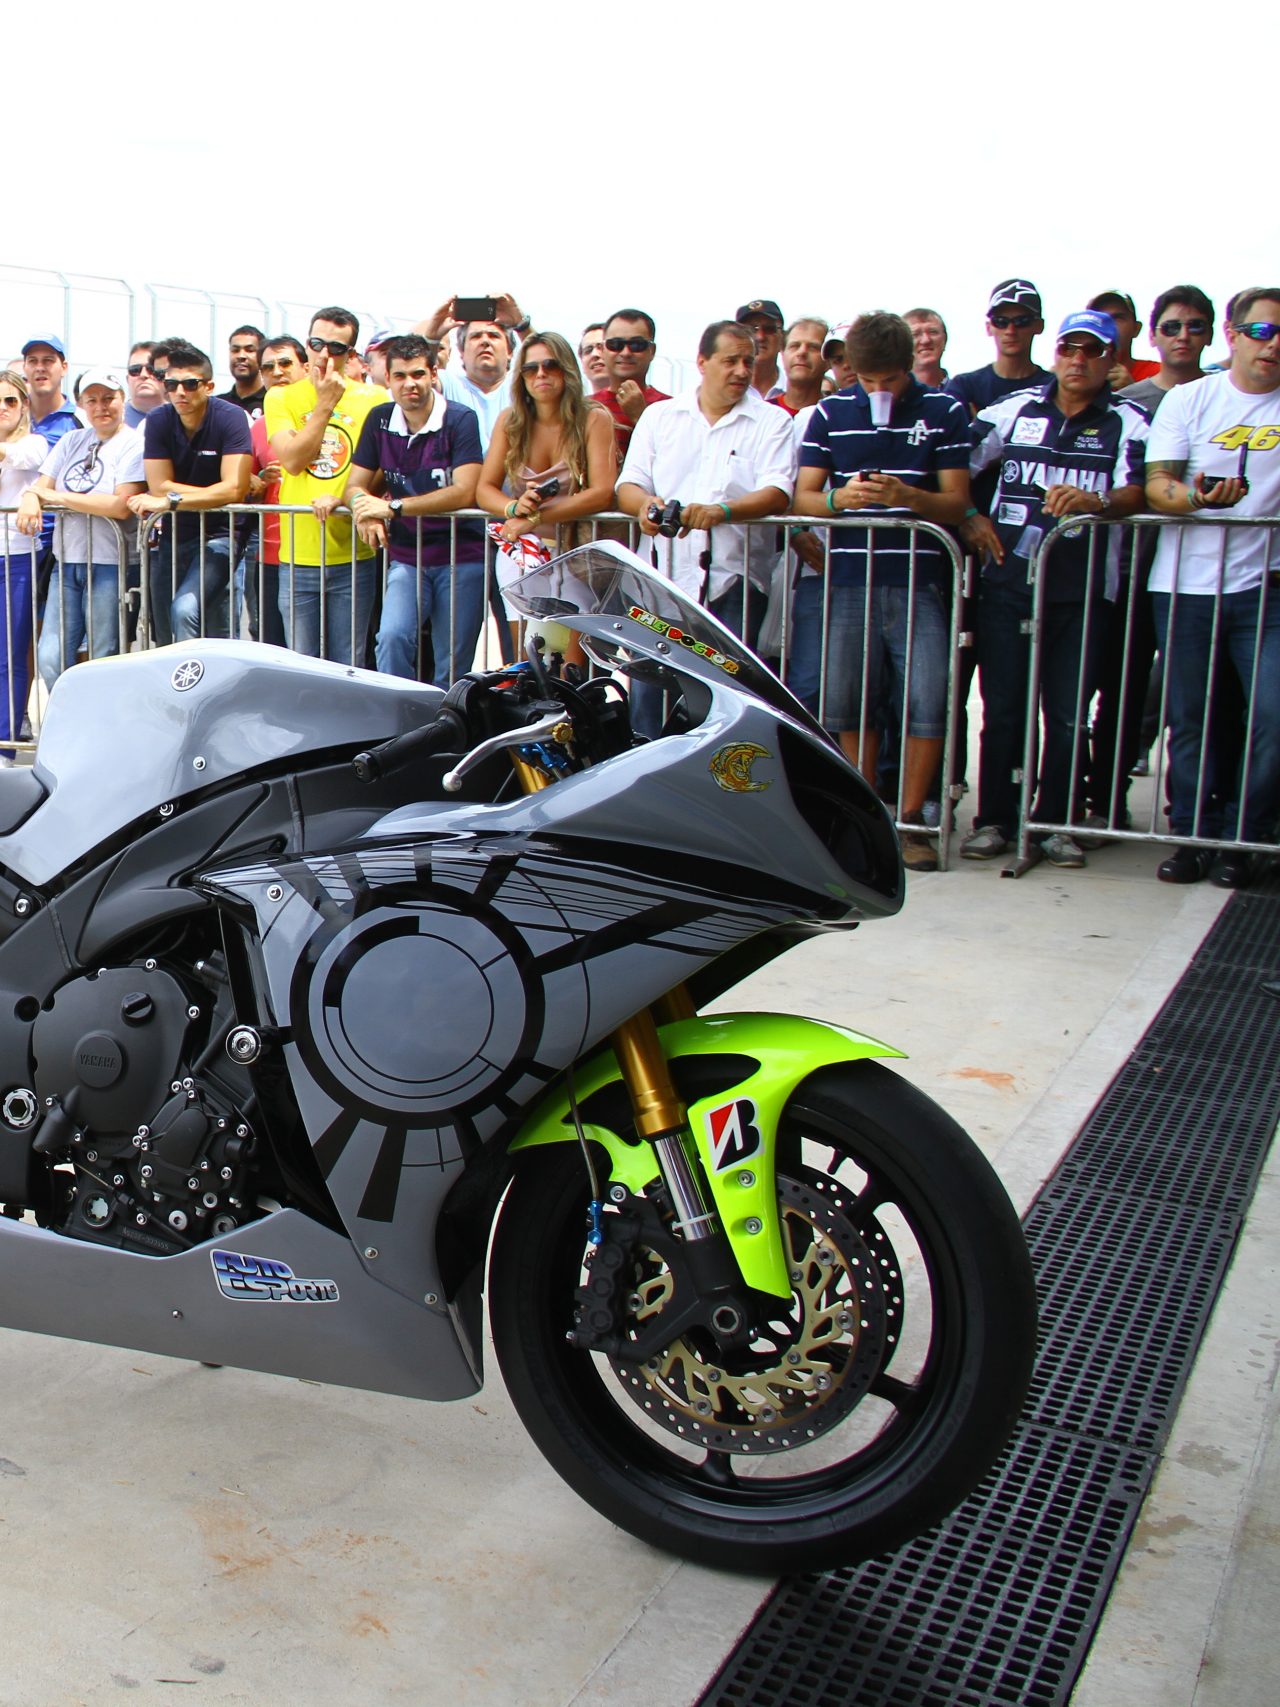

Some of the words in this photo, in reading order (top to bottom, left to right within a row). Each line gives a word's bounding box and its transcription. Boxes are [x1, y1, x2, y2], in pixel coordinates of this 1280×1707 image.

[1207, 424, 1280, 451] 46
[1021, 460, 1108, 494] YAMAHA
[627, 606, 670, 633] THE
[666, 626, 739, 674] DOCTOR
[80, 1054, 116, 1068] YAMAHA
[212, 1250, 293, 1279] AUTO
[217, 1271, 339, 1300] ESPORTE
